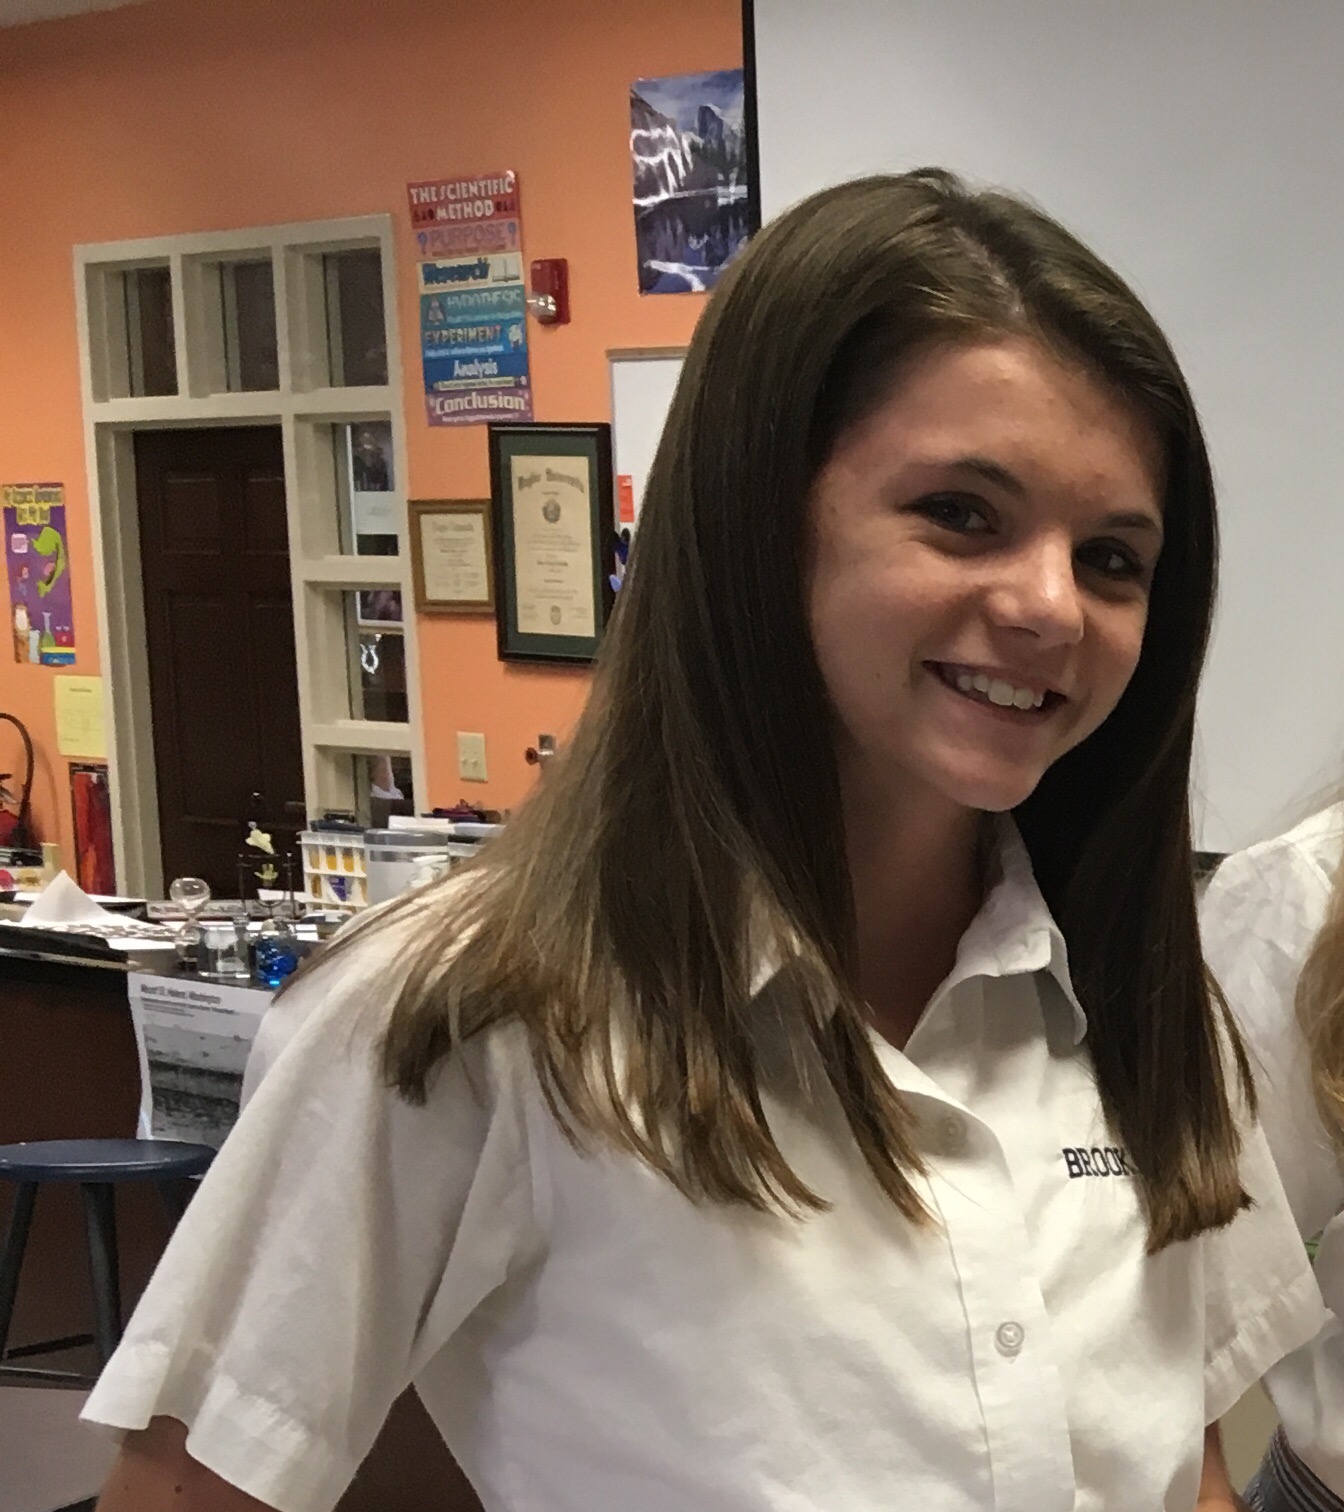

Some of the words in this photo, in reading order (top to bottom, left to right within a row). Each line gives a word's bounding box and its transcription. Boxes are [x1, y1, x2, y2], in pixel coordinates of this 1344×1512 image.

[410, 185, 437, 204] THE
[440, 176, 514, 201] SCIENTIFIC
[436, 200, 494, 220] METHOD
[425, 325, 501, 345] EXPERIMENT
[435, 391, 525, 415] Conclusion
[1062, 1147, 1136, 1179] BROOK
